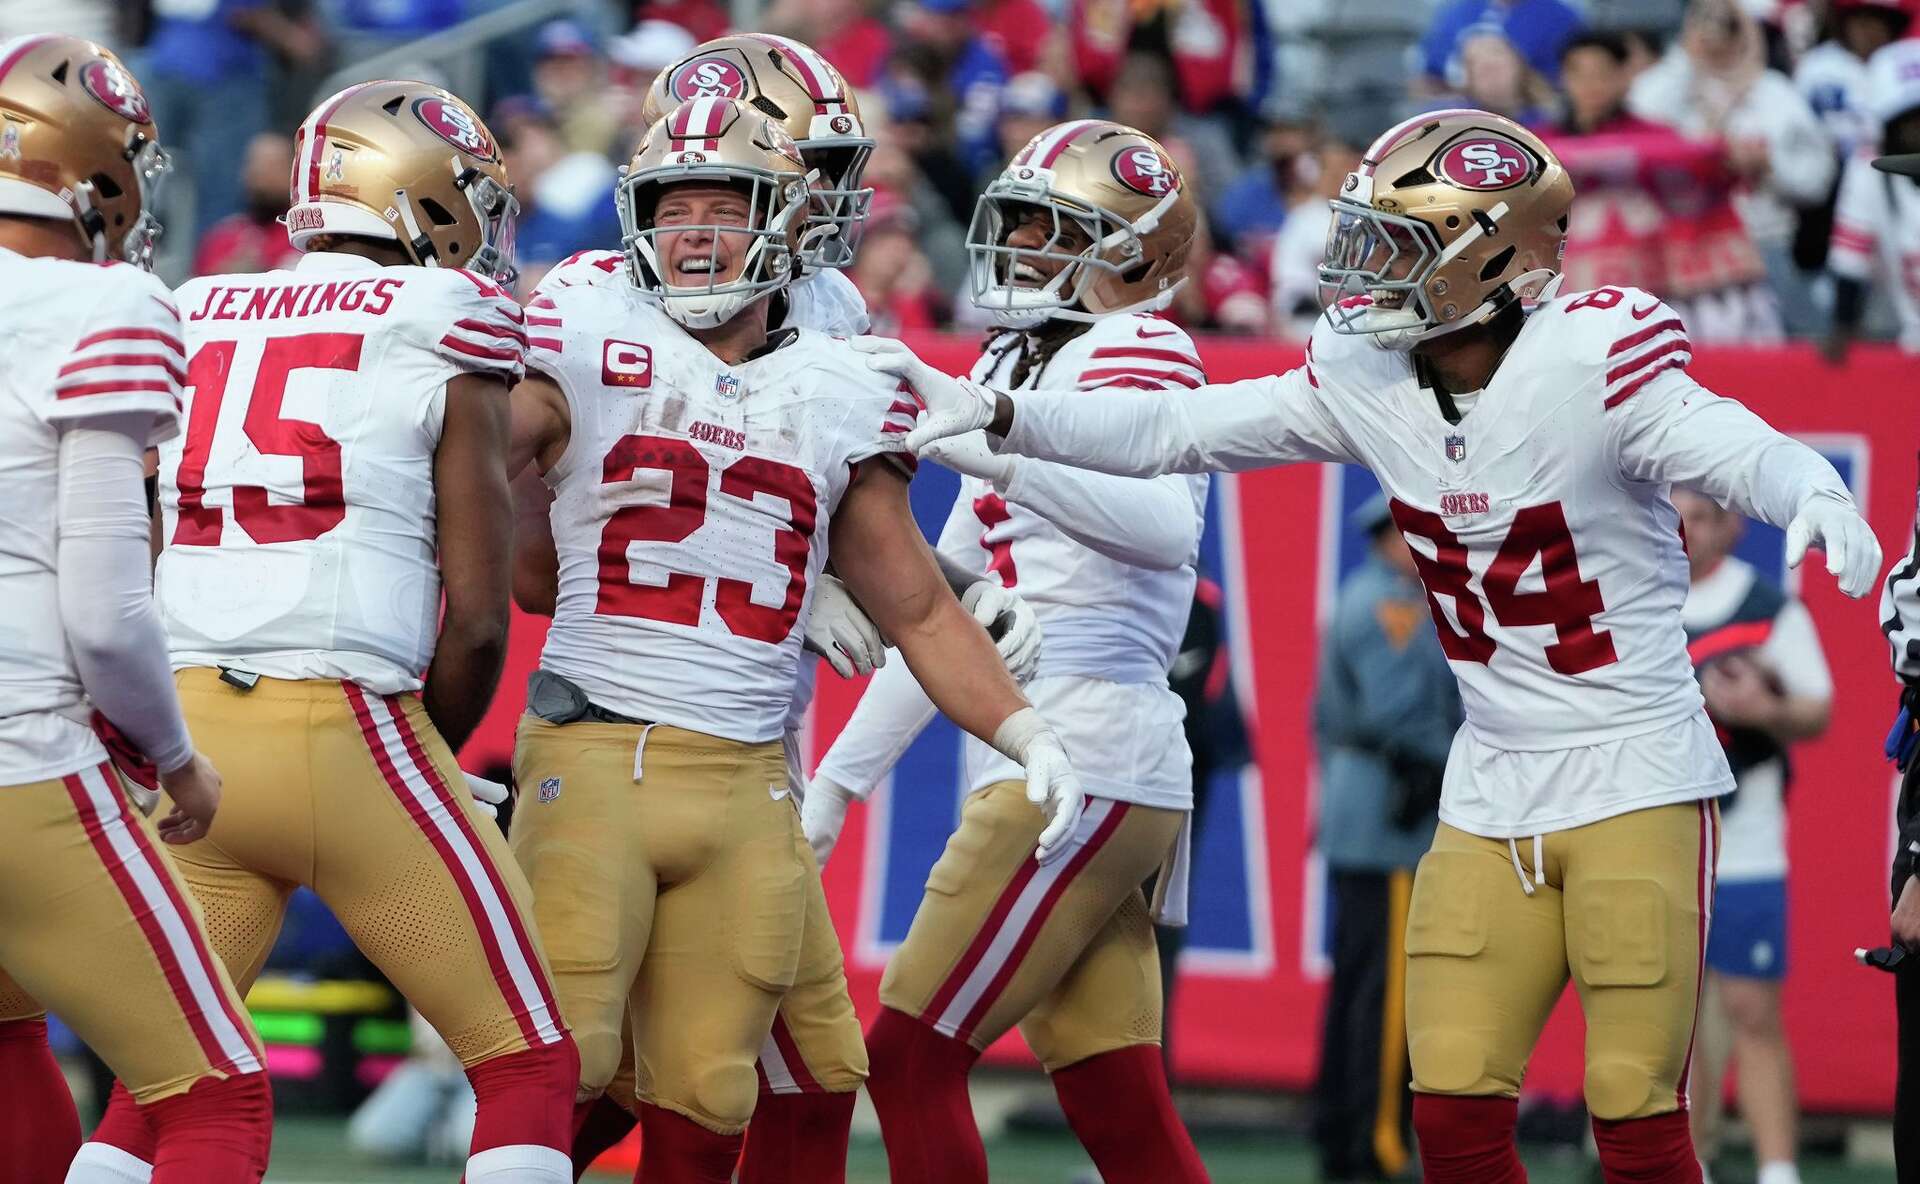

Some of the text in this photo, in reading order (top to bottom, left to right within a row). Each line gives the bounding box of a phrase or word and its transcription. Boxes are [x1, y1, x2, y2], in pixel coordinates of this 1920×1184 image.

[1461, 143, 1519, 186] SF
[189, 278, 405, 321] JENNINGS
[606, 342, 649, 375] C
[171, 332, 365, 546] 15
[688, 420, 747, 451] 49ERS
[1440, 493, 1489, 515] 49ERS
[594, 433, 818, 645] 23
[1389, 496, 1618, 675] 84
